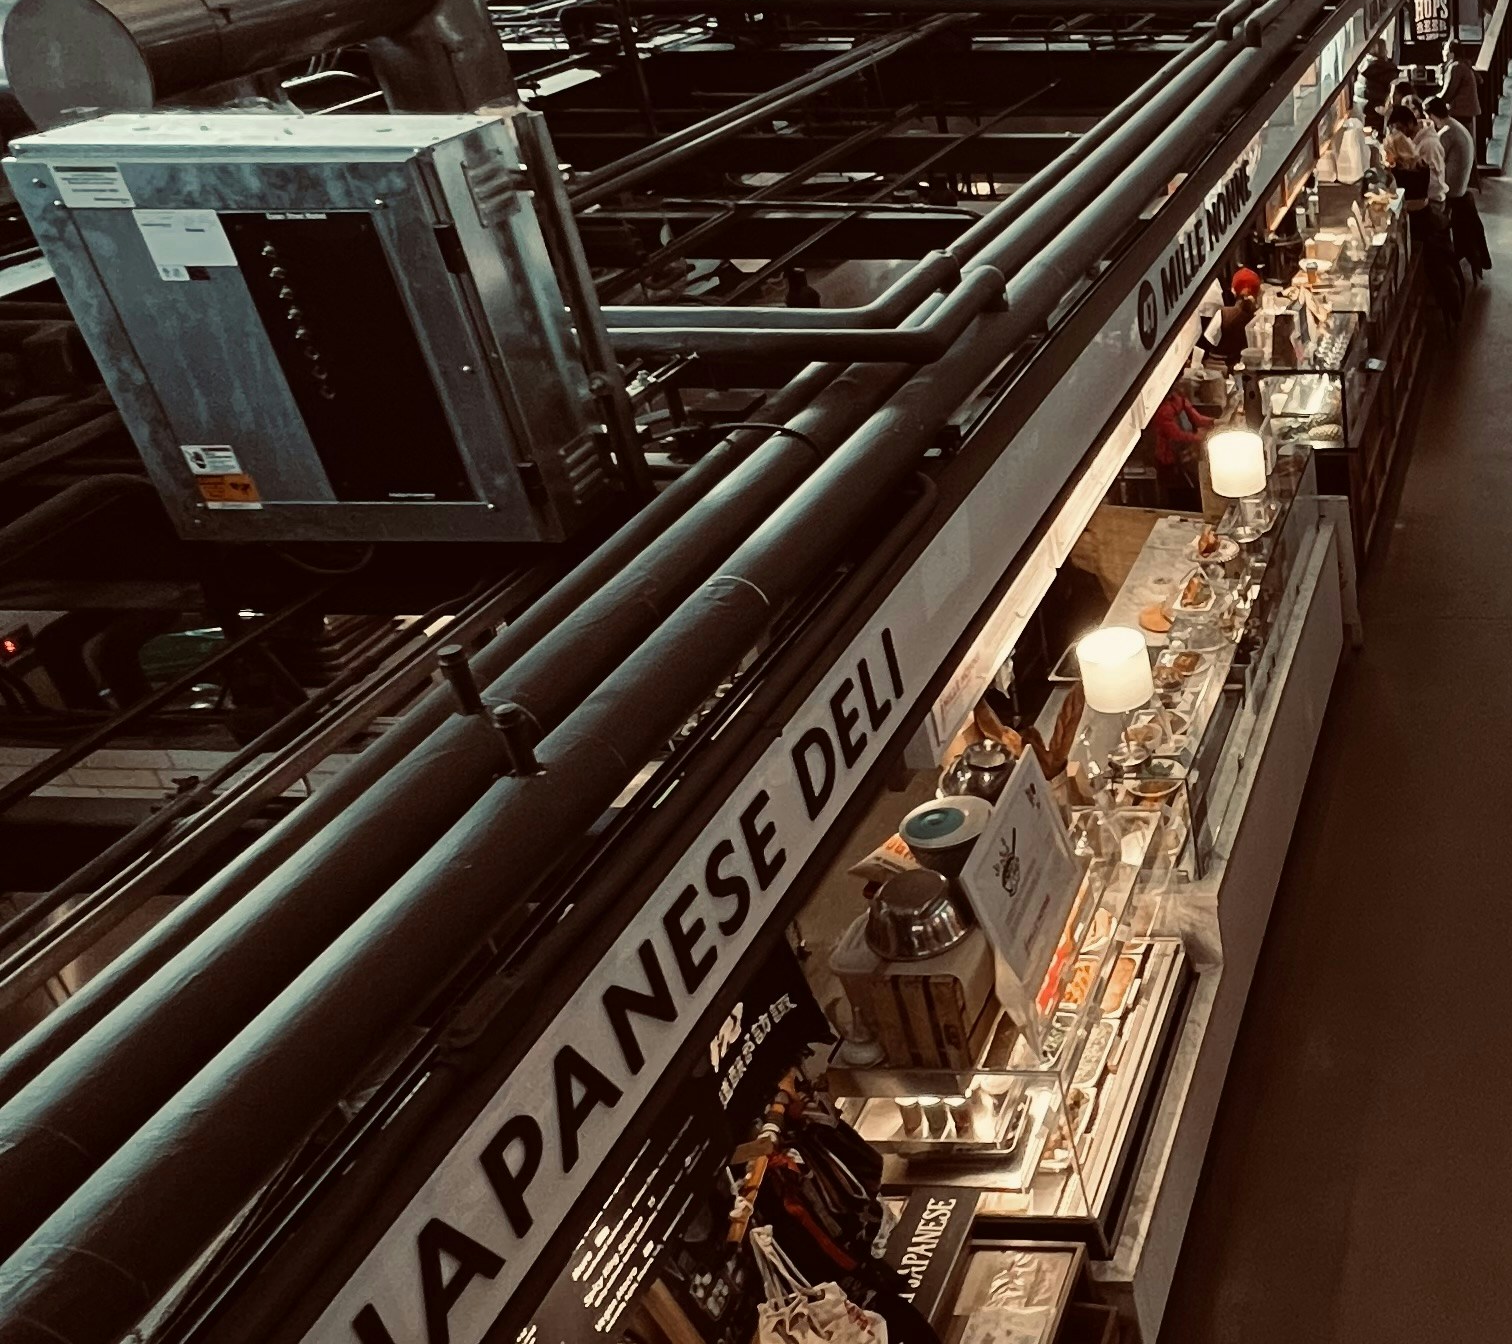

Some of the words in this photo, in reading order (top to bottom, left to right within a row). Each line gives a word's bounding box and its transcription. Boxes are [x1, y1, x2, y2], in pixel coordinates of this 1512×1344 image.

[1161, 219, 1207, 316] MILLE
[1205, 158, 1252, 251] NONNE
[790, 627, 905, 822] DELI
